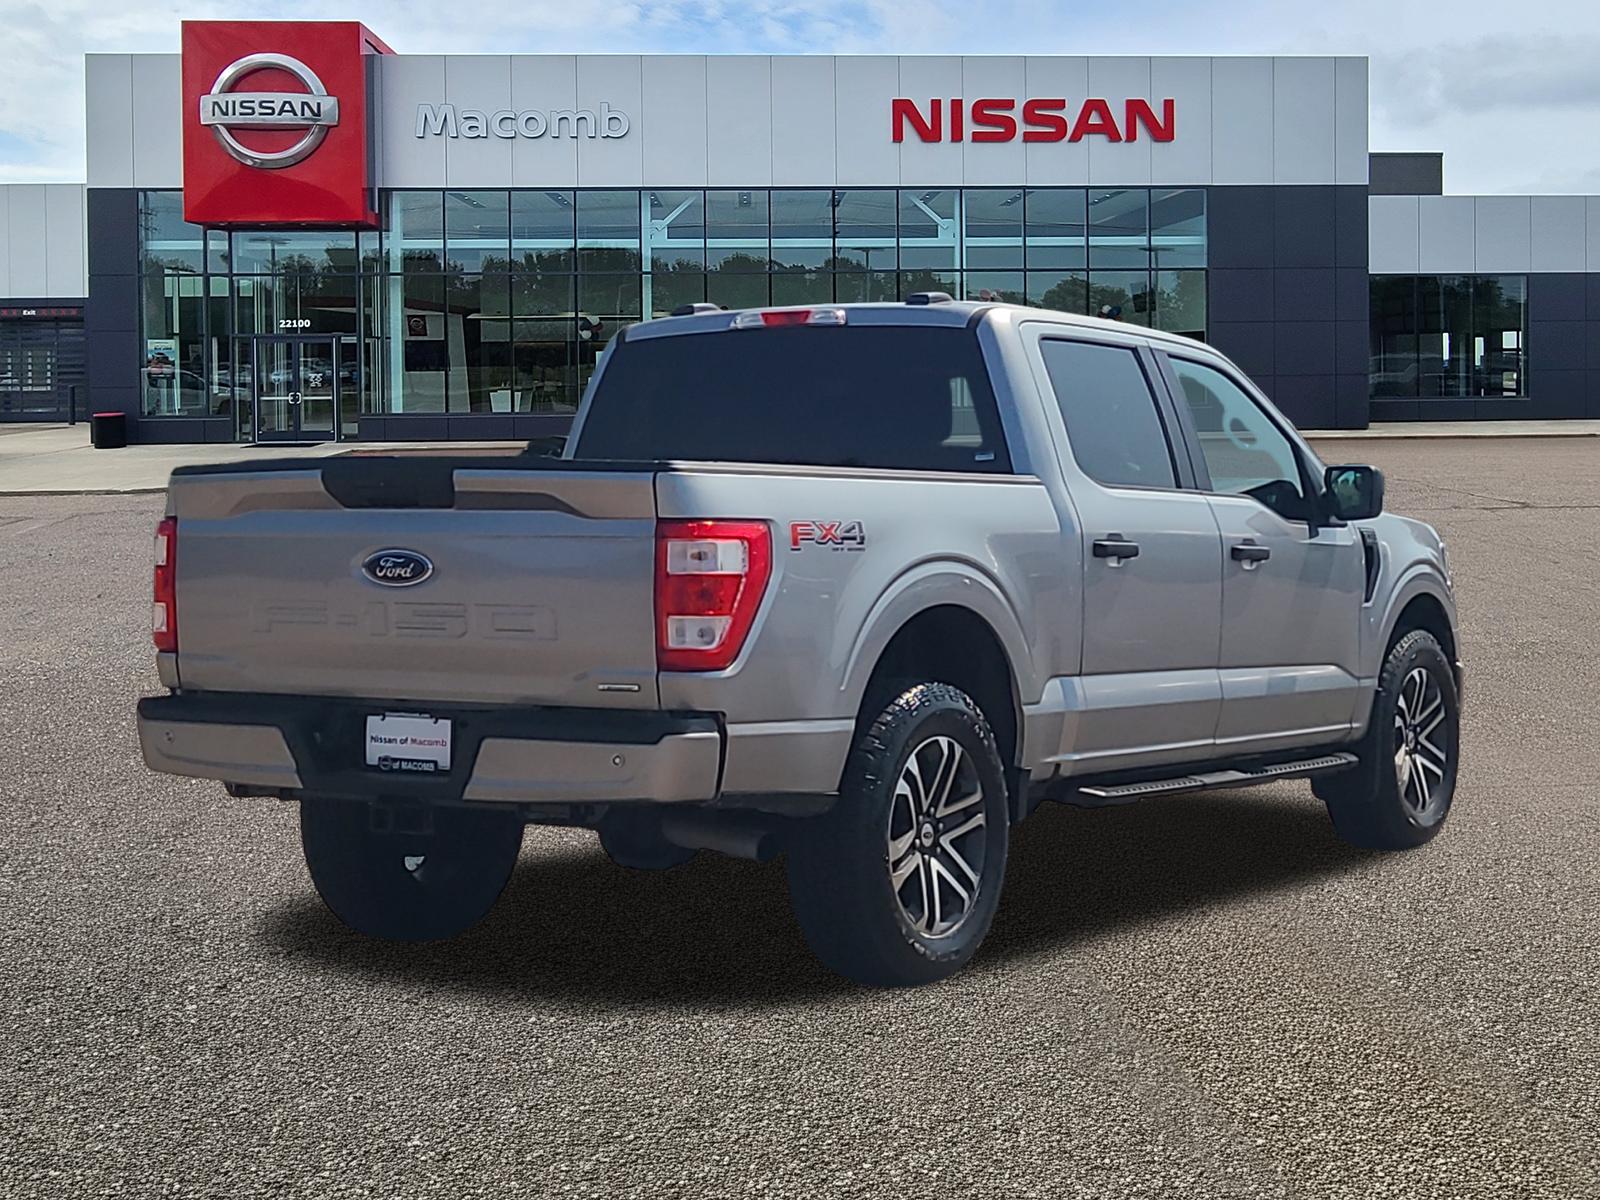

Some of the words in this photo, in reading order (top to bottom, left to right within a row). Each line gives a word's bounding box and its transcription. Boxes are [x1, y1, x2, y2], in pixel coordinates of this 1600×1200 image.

[211, 100, 322, 118] NISSAN
[415, 102, 630, 139] Macomb
[892, 98, 1175, 143] NISSAN
[279, 319, 311, 328] 22100
[790, 520, 865, 551] FX4
[376, 557, 415, 578] Ford
[252, 601, 559, 641] F-150
[370, 735, 398, 745] Nissan
[399, 736, 409, 745] of
[410, 737, 448, 748] Macomb
[401, 761, 435, 771] MACOMB
